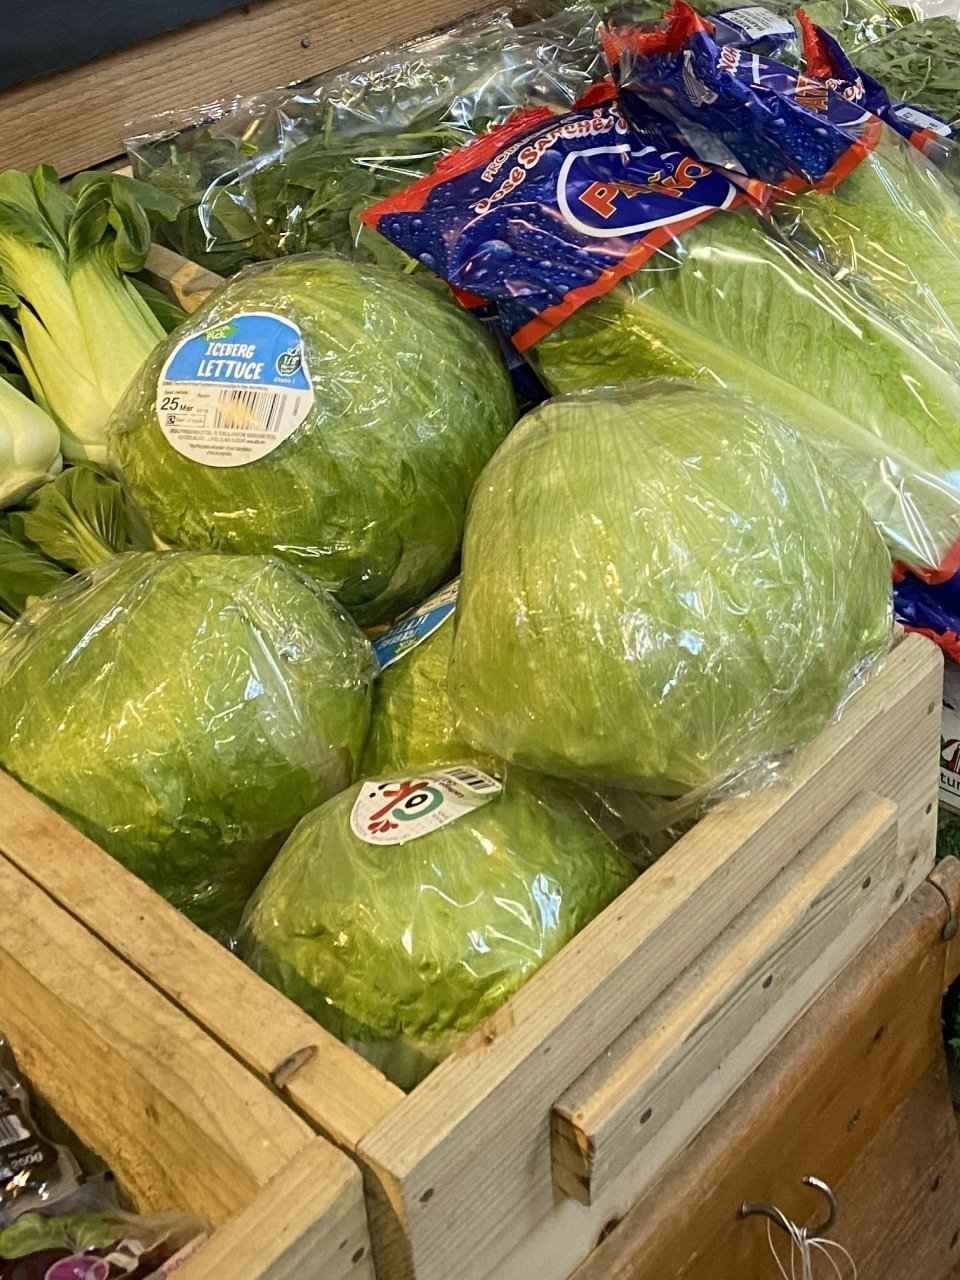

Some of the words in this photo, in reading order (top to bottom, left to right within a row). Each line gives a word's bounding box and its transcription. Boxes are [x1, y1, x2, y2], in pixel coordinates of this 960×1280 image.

[205, 342, 257, 359] ICEBERG
[196, 360, 265, 381] LETTUCE
[160, 397, 180, 412] 25
[179, 404, 194, 412] Mar
